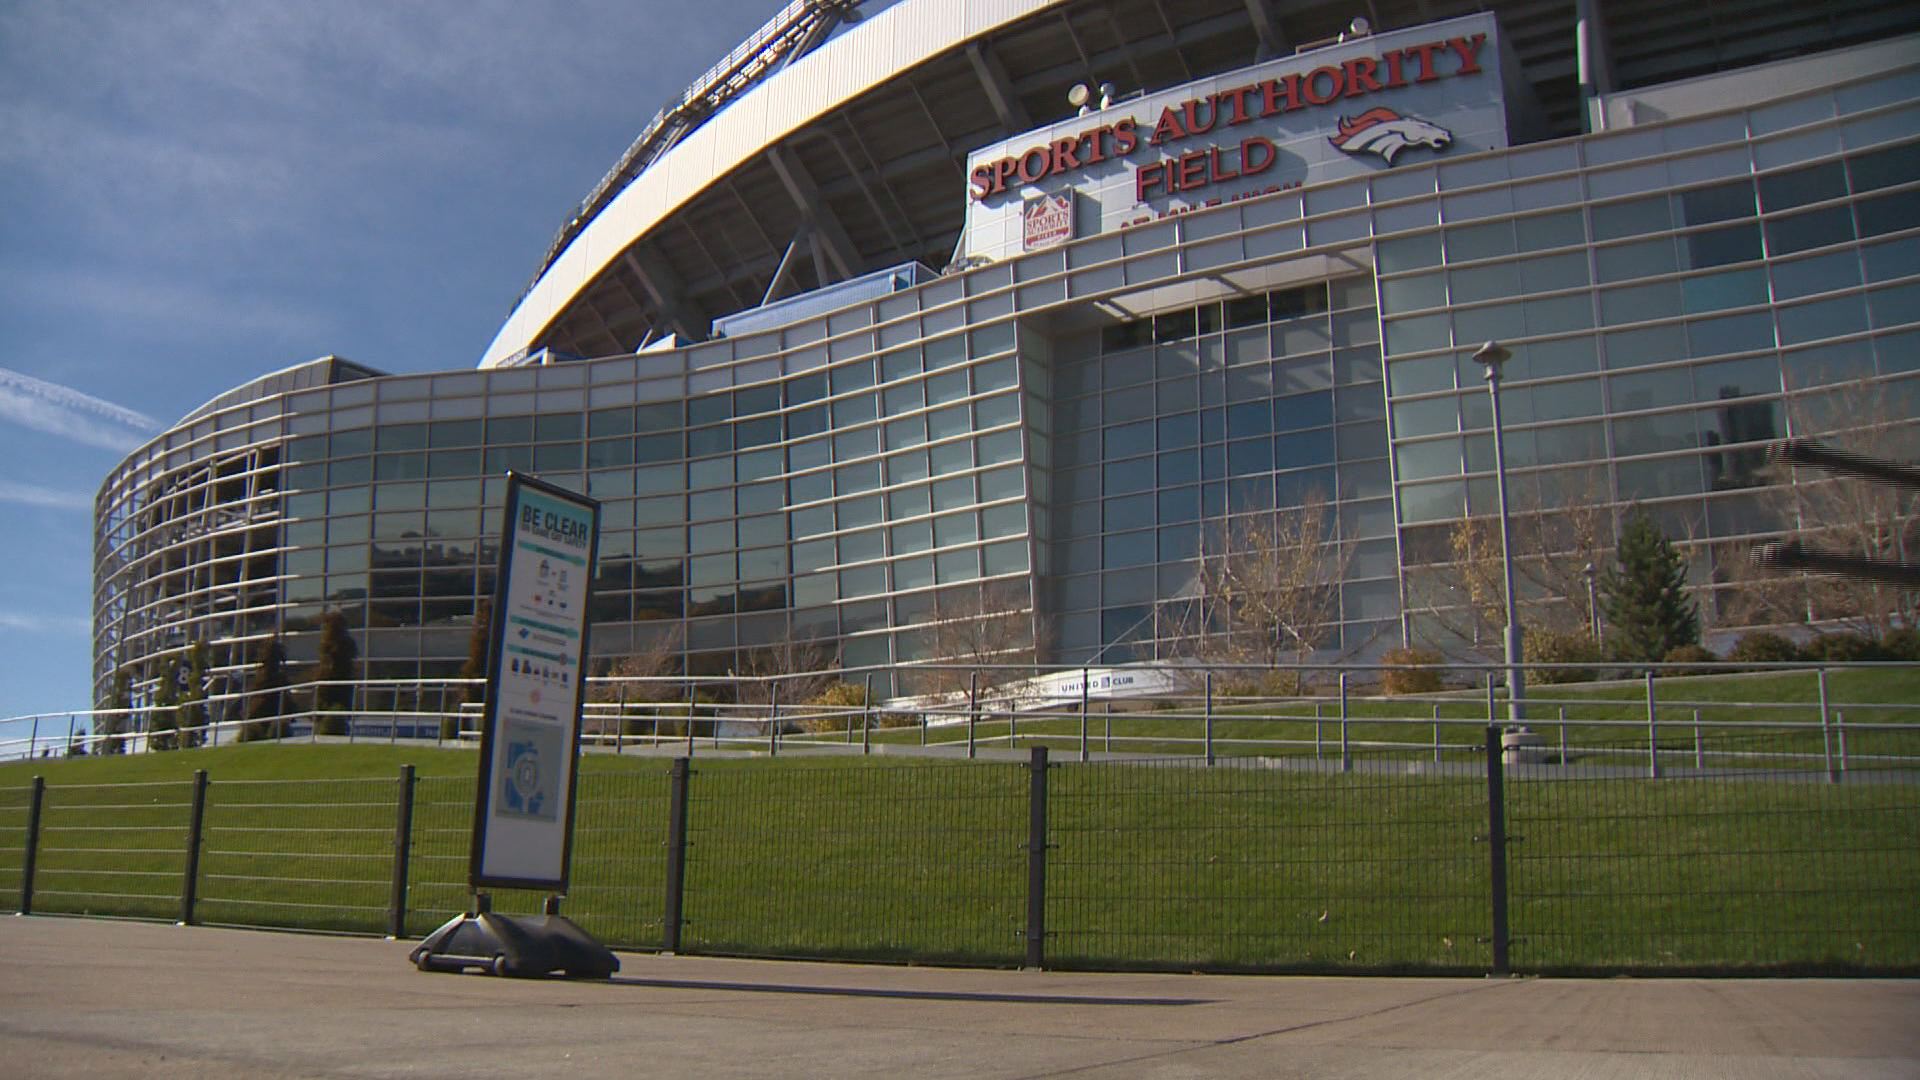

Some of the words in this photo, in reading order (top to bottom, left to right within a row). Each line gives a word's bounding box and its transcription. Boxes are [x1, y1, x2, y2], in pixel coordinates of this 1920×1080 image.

[969, 115, 1137, 200] SPORTS
[1150, 33, 1487, 145] AUTHORITY
[1136, 136, 1277, 201] FIELD
[1026, 208, 1069, 228] SPORTS
[522, 504, 541, 526] BE
[545, 511, 588, 540] CLEAR
[1113, 676, 1134, 685] CLUB
